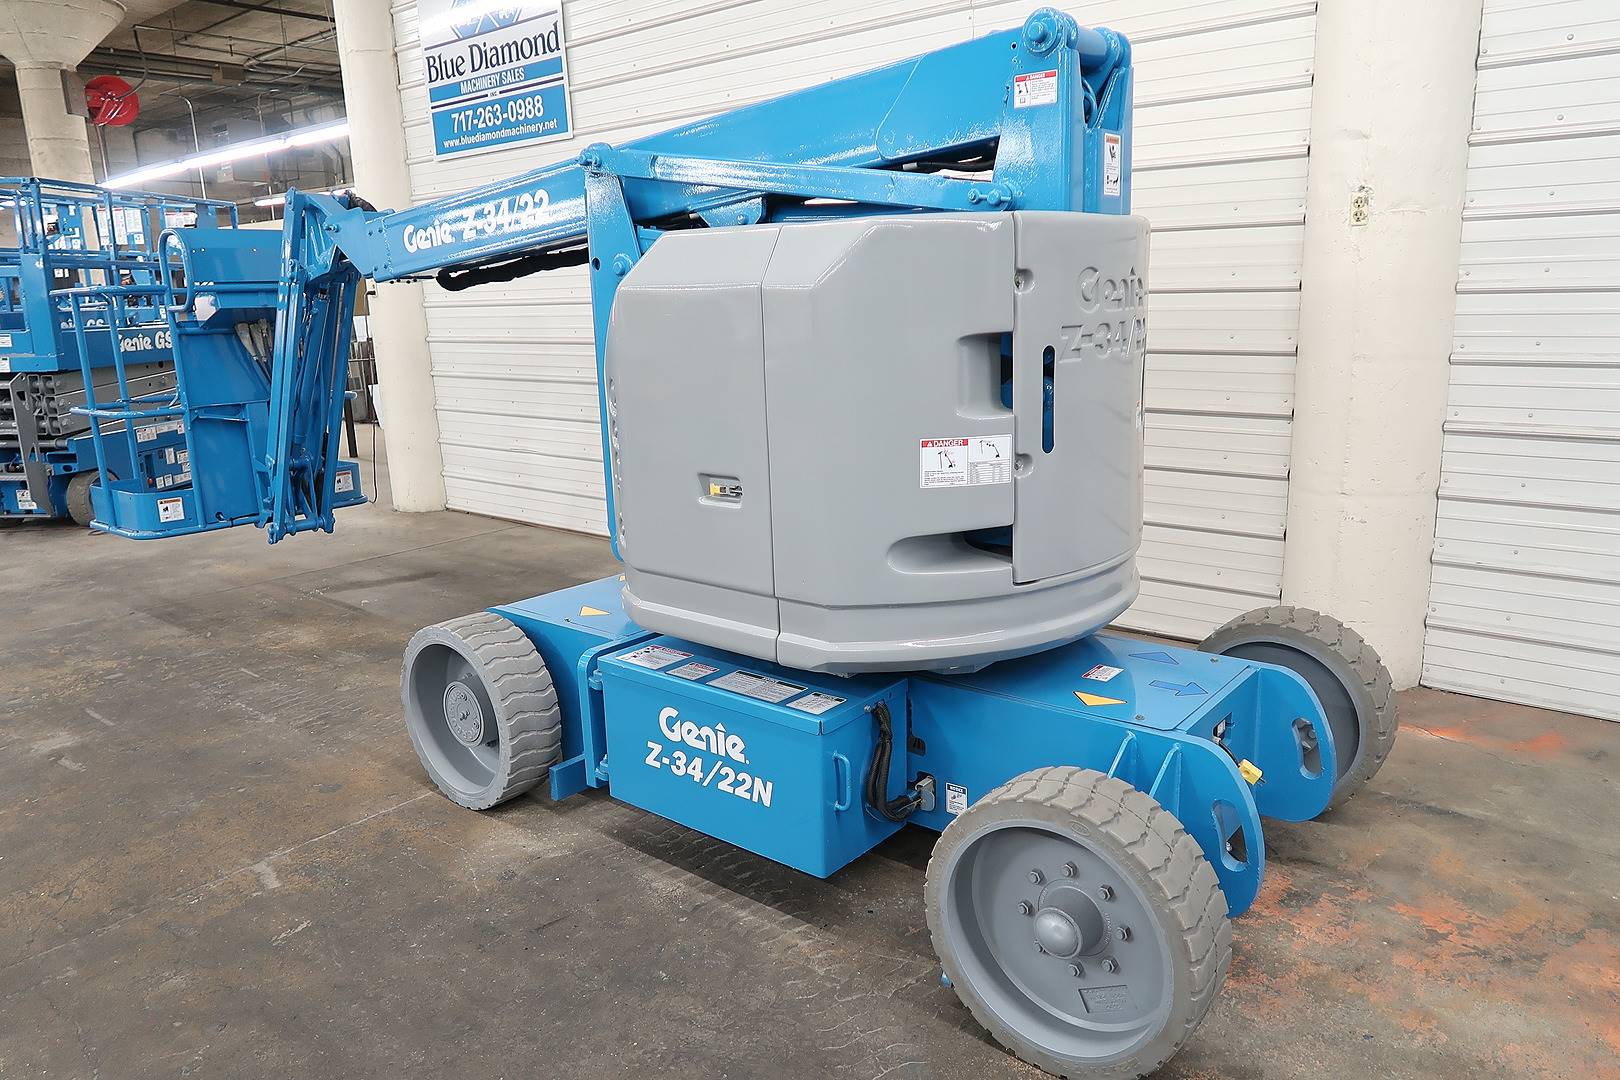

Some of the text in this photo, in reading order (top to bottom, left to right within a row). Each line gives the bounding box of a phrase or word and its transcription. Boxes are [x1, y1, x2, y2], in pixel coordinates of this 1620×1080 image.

[426, 20, 561, 83] Blue Diamond
[460, 67, 525, 95] MACHINERY SALES
[451, 95, 544, 133] 717-263-0988
[443, 118, 558, 148] www.bluediamondmachinery.net
[403, 218, 456, 253] Genie
[933, 439, 964, 447] DANGER
[658, 706, 750, 765] Genie
[645, 741, 774, 808] Z-34/22N
